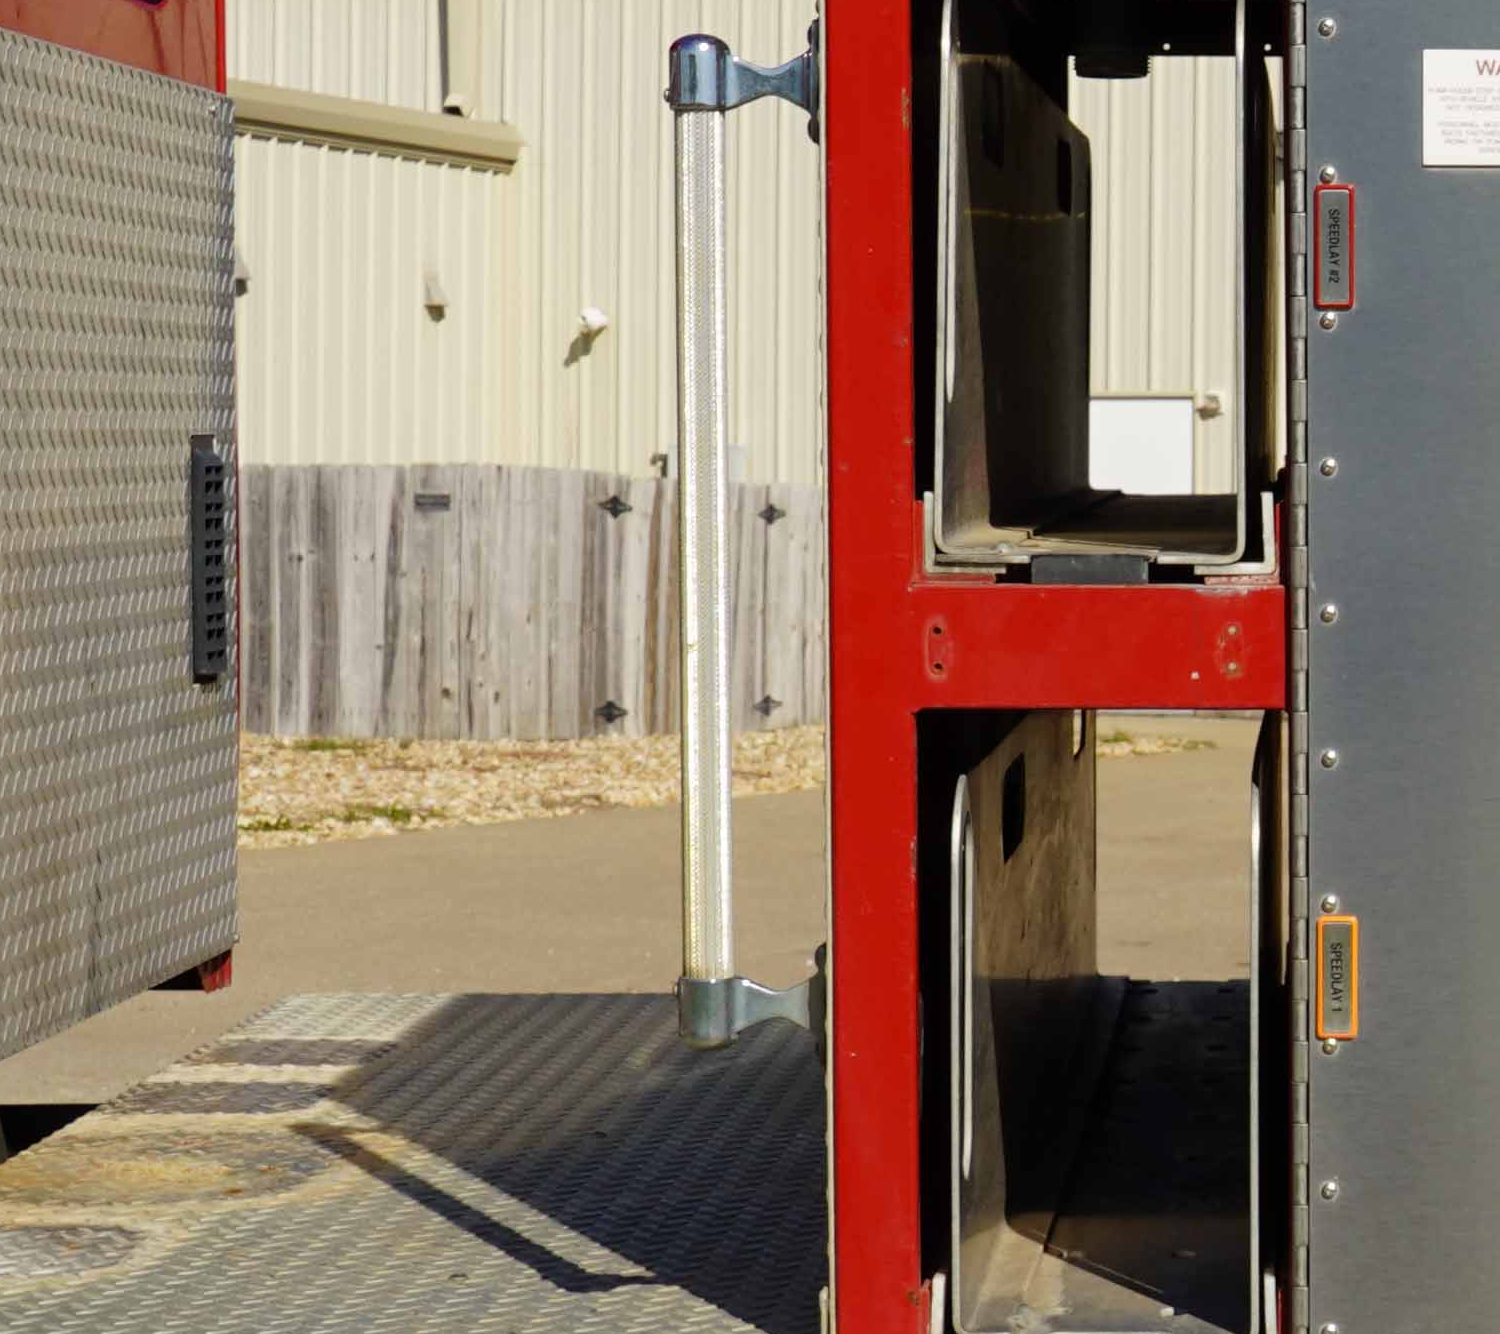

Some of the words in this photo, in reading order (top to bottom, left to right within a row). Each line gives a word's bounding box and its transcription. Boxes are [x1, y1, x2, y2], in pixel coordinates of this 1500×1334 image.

[1328, 208, 1341, 269] SPEEDLAY
[1328, 270, 1340, 284] #2
[1330, 942, 1343, 1006] SPEEDLAY
